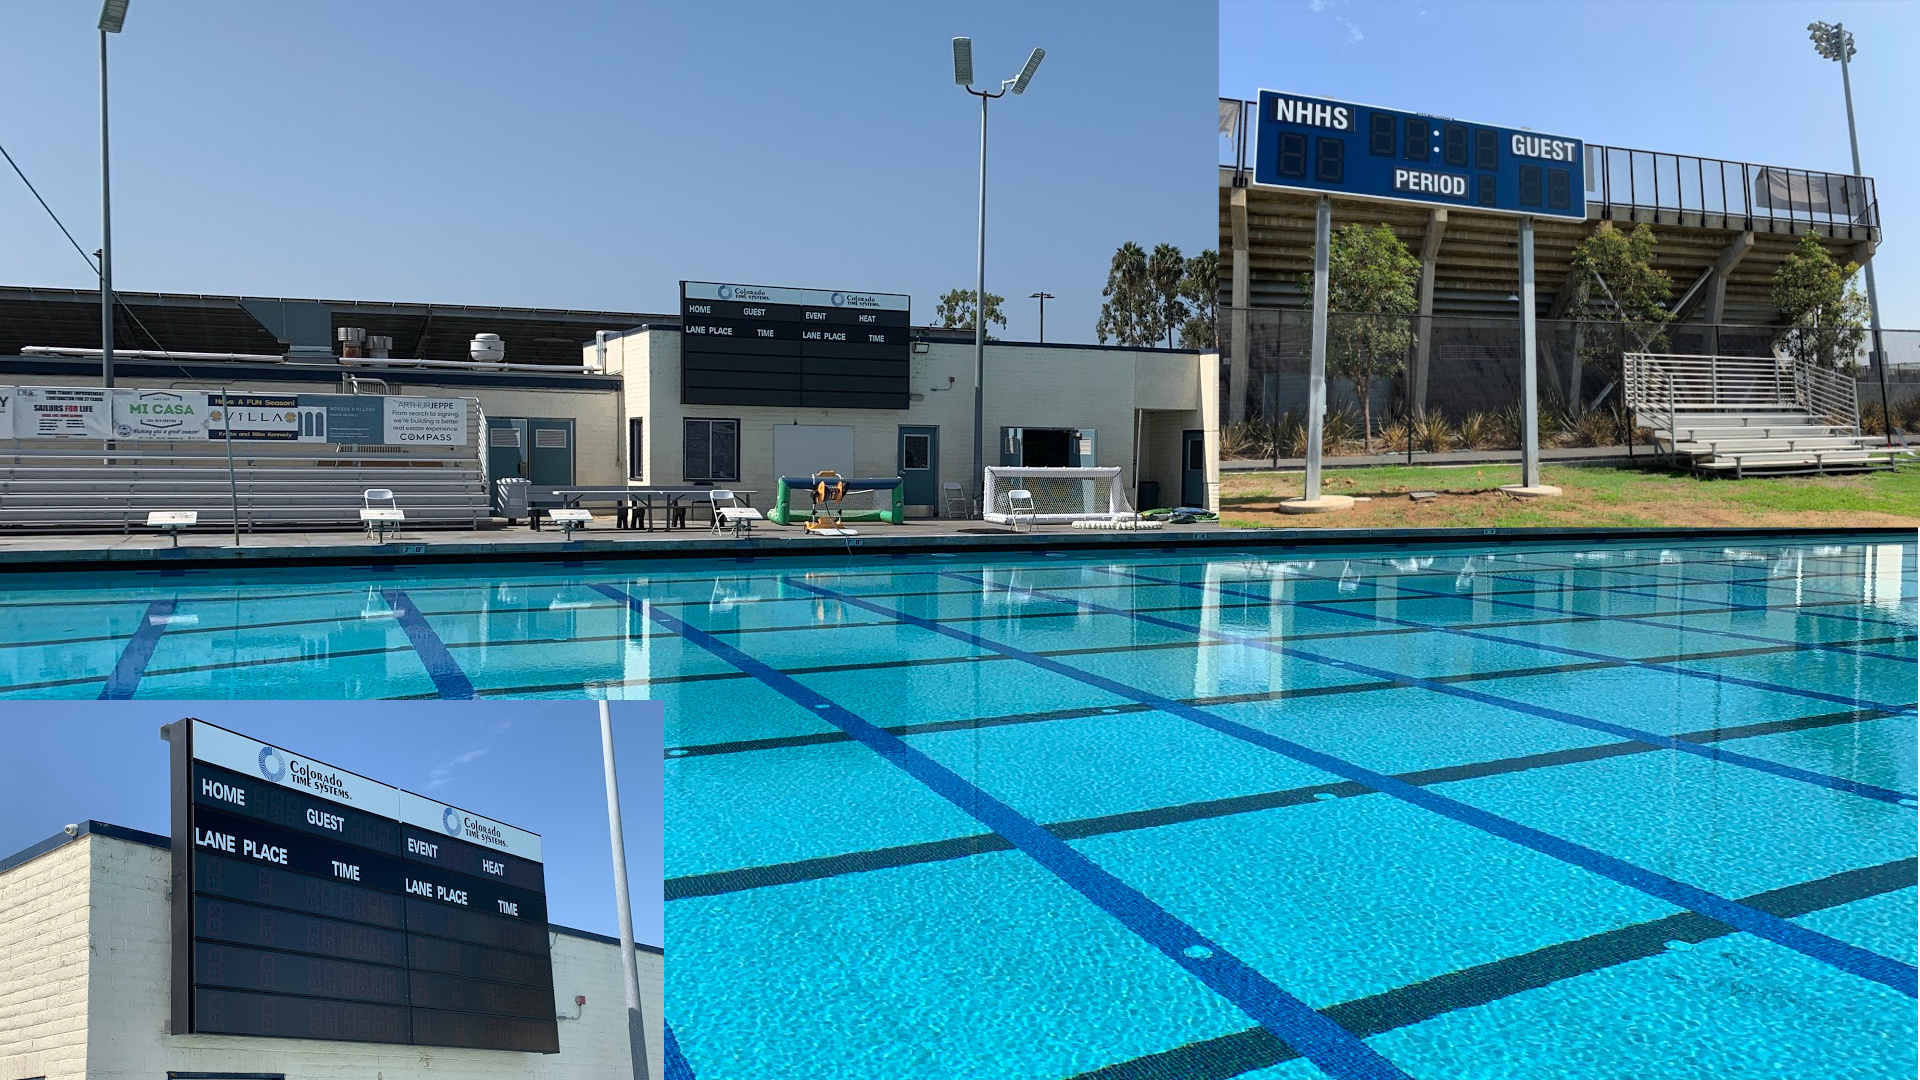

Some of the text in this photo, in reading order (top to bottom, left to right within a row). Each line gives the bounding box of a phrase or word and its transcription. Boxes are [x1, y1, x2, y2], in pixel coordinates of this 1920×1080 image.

[1276, 98, 1349, 130] NHHS
[1511, 134, 1576, 162] GUEST
[1395, 169, 1466, 195] PERIOD
[689, 305, 711, 313] HOME
[743, 307, 766, 316] GUEST
[805, 311, 827, 320] EVENT
[859, 314, 876, 322] HEAT
[685, 325, 733, 335] LANE PLACE
[757, 329, 774, 337] TIME
[802, 331, 846, 340] LANE PLACE
[868, 334, 885, 342] TIME
[34, 404, 63, 412] SAILORS
[129, 404, 194, 415] MI CASA
[400, 433, 452, 441] COMPASS
[290, 760, 343, 788] Colorado
[290, 773, 312, 788] TIME
[202, 778, 245, 806] HOME
[306, 808, 344, 832] GUEST
[464, 817, 501, 838] Colorado
[465, 828, 480, 840] TIME
[195, 827, 288, 865] LANE PLACE
[407, 837, 438, 859] EVENT
[331, 860, 361, 882] TIME
[482, 858, 504, 876] HEAT
[405, 877, 468, 905] LANE PLACE
[497, 899, 519, 917] TIME
